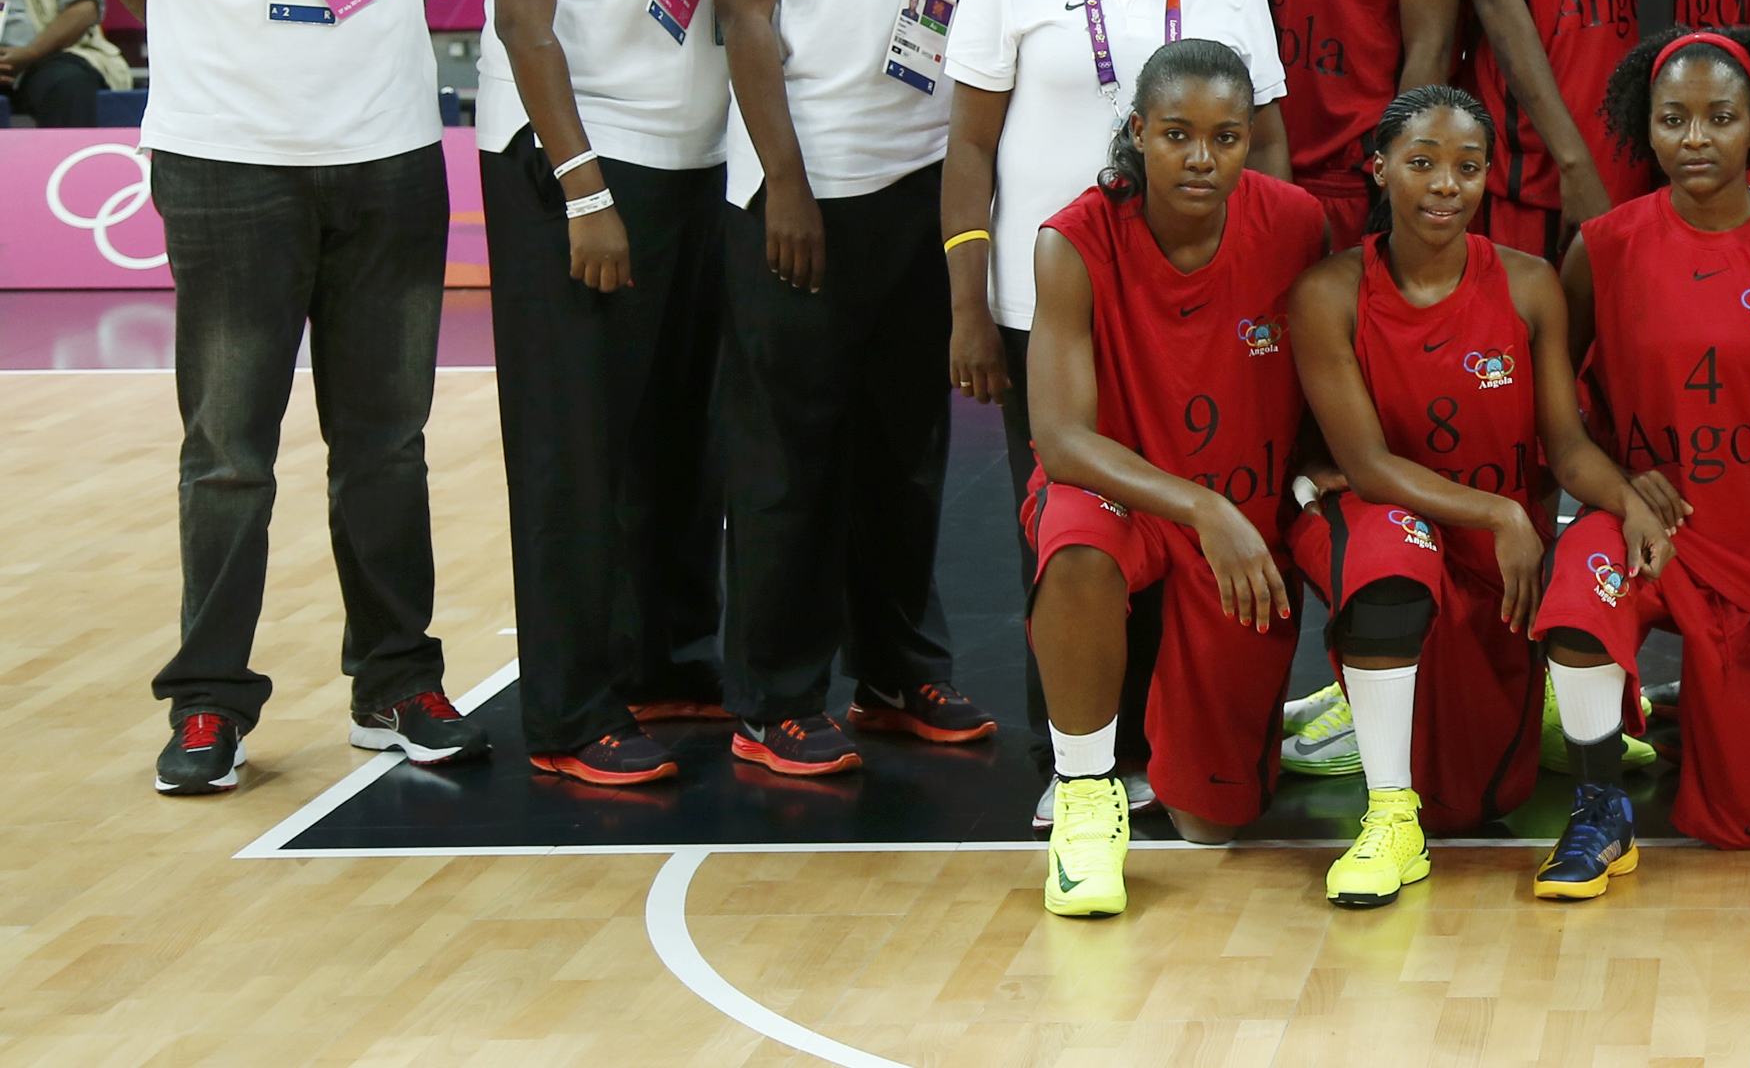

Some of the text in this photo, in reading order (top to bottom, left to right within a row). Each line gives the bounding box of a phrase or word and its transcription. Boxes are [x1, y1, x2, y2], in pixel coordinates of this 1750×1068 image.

[282, 7, 290, 17] 2
[324, 11, 331, 19] R
[898, 68, 906, 77] 2
[1248, 343, 1280, 357] Angola
[1478, 375, 1514, 391] Angola
[1683, 346, 1724, 405] 4
[1184, 393, 1220, 458] 9
[1426, 396, 1461, 454] 8
[1404, 533, 1438, 553] Angola
[1593, 584, 1617, 608] Angola
